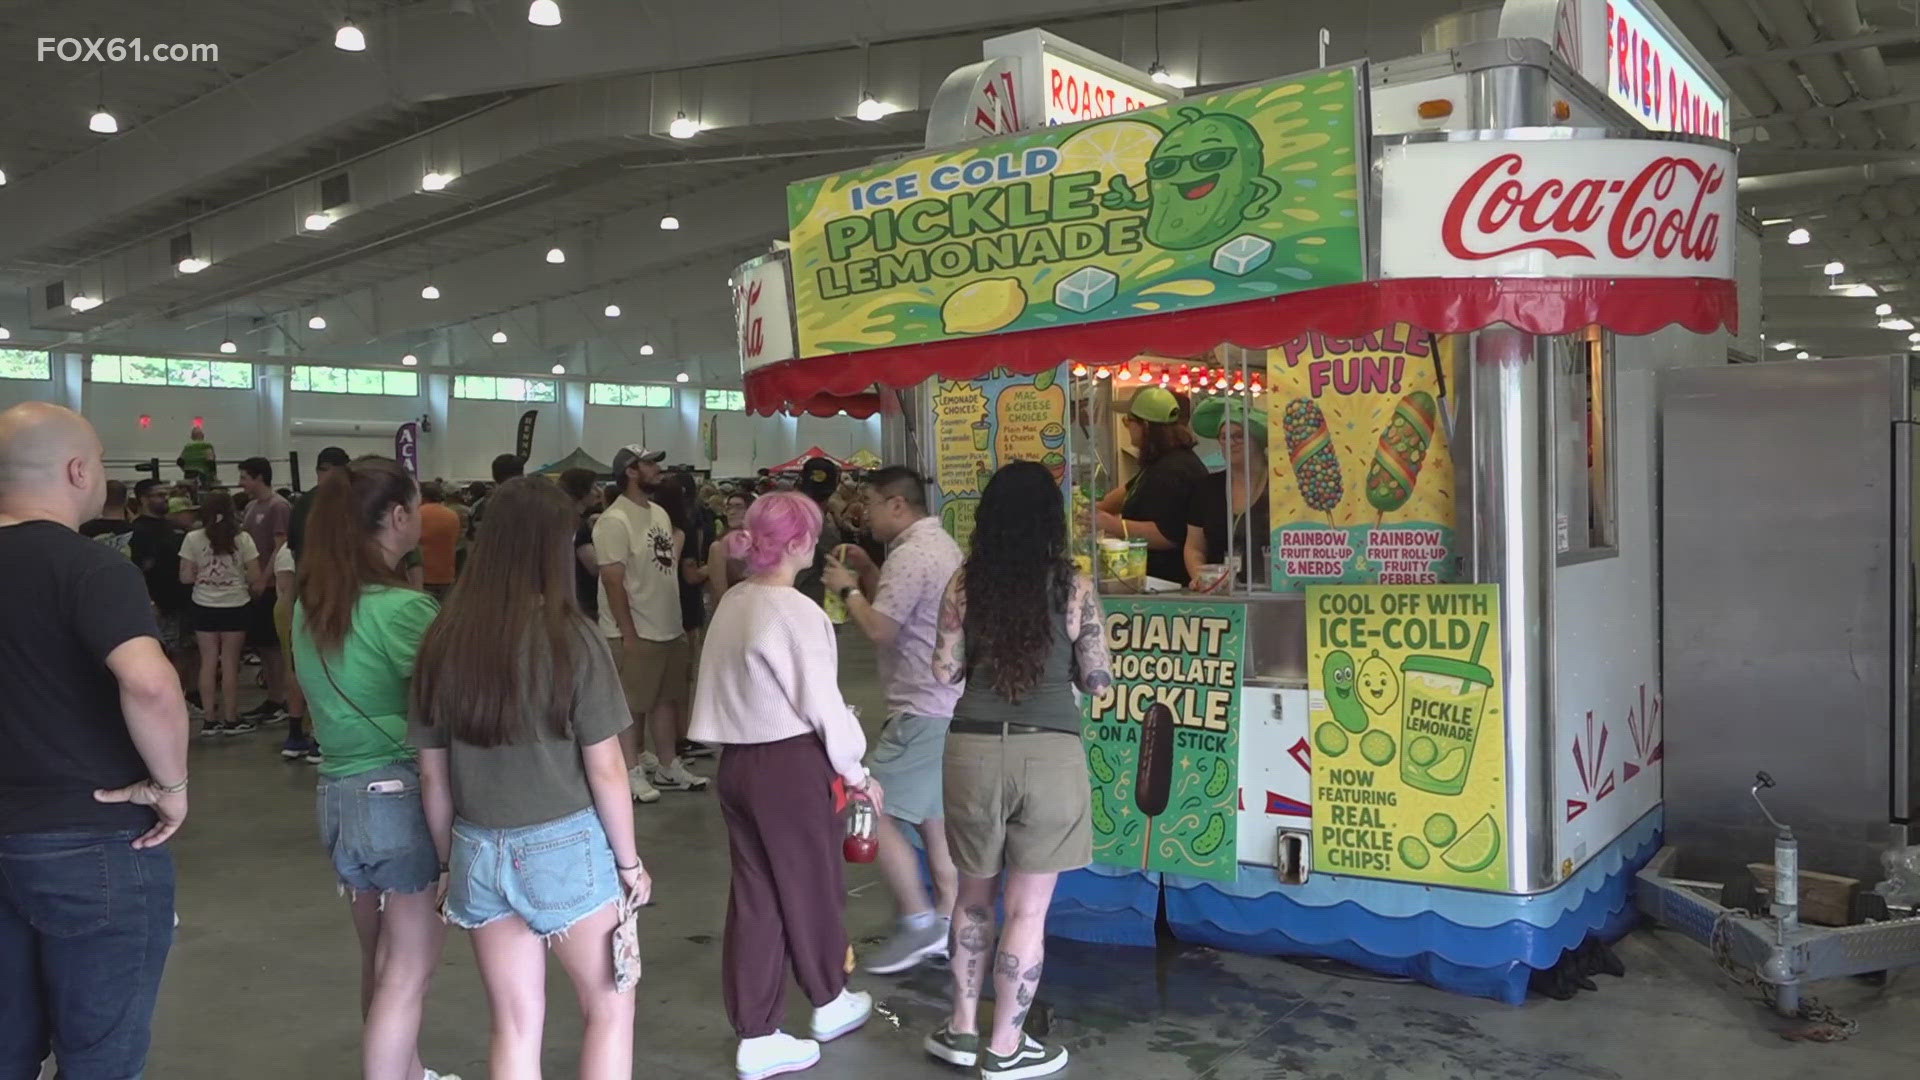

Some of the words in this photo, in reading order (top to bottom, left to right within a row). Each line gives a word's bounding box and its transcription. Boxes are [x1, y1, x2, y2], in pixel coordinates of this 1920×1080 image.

[1051, 68, 1116, 121] ROAST
[850, 173, 919, 211] ICE
[929, 147, 1058, 192] COLD
[824, 171, 1101, 262] PICKLE
[1442, 153, 1725, 262] Coca-Cola
[816, 216, 1145, 300] LEMONADE
[1309, 356, 1405, 398] FUN!
[940, 395, 979, 406] LEMONADE
[1013, 400, 1051, 411] CHEESE
[1014, 391, 1036, 401] MAC
[1008, 411, 1048, 422] CHOICES
[1282, 532, 1348, 546] RAINBOW
[1370, 532, 1440, 546] RAINBOW
[1281, 548, 1312, 559] FRUIT
[1312, 548, 1353, 559] ROLL-UP
[1368, 548, 1401, 559] FRUIT
[1401, 548, 1447, 559] ROLL-UP
[1287, 562, 1296, 575] &
[1298, 561, 1343, 575] NERDS
[1384, 561, 1428, 572] FRUITY
[1380, 573, 1436, 585] PEBBLES
[1318, 593, 1375, 615] COOL
[1380, 593, 1420, 615] OFF
[1426, 593, 1488, 616] WITH
[1106, 613, 1230, 656] GIANT
[1319, 618, 1471, 650] ICE-COLD
[1110, 654, 1236, 686] HOCOLATE
[1090, 683, 1232, 732] PICKLE
[1410, 697, 1473, 726] PICKLE
[1099, 725, 1121, 742] ON
[1126, 727, 1137, 743] A
[1177, 731, 1227, 753] STICK
[1406, 715, 1474, 743] LEMONADE
[1329, 769, 1374, 787] NOW
[1318, 786, 1398, 807] FEATURING
[1331, 805, 1386, 829] REAL
[1322, 826, 1393, 851] PICKLE
[1327, 849, 1391, 872] CHIPS!
